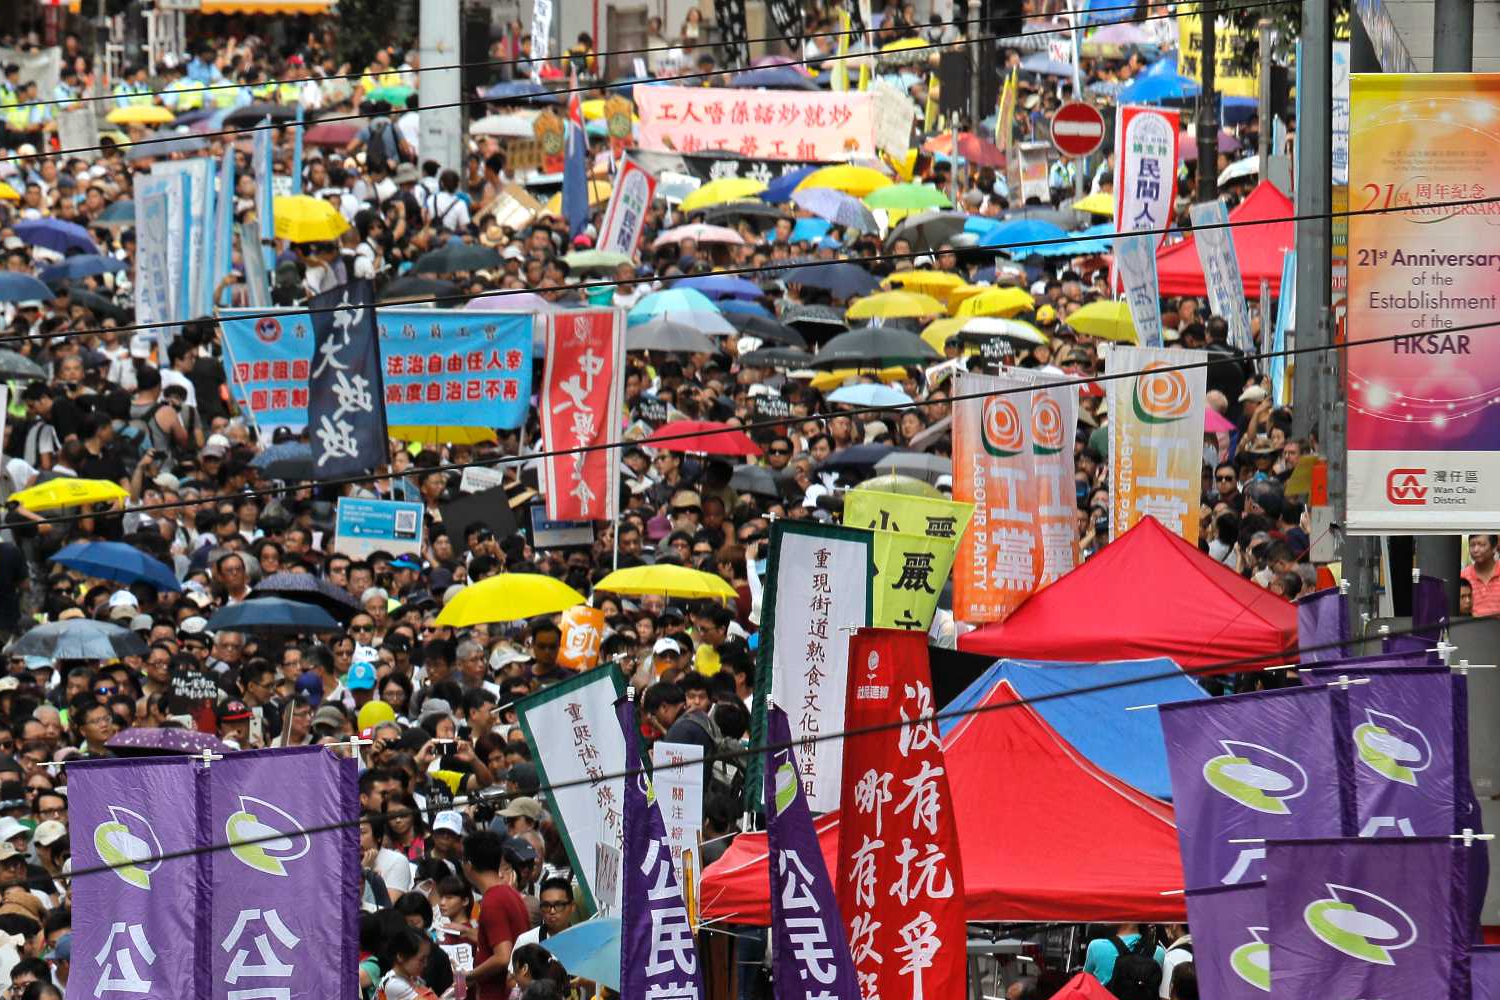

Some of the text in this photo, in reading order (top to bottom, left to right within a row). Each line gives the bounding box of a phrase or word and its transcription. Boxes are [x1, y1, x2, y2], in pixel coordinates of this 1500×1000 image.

[1416, 183, 1485, 199] 周年紀念
[1358, 249, 1388, 266] 21st
[1411, 271, 1453, 286] of the
[1369, 290, 1497, 309] Establishment
[1411, 314, 1453, 329] of the
[1393, 335, 1471, 354] HKSAR
[1433, 470, 1478, 483] 灣仔區
[1455, 486, 1477, 494] Chai
[1433, 496, 1467, 505] District
[973, 532, 988, 592] PARTY
[799, 548, 832, 798] 重現街道熱食文化關注組
